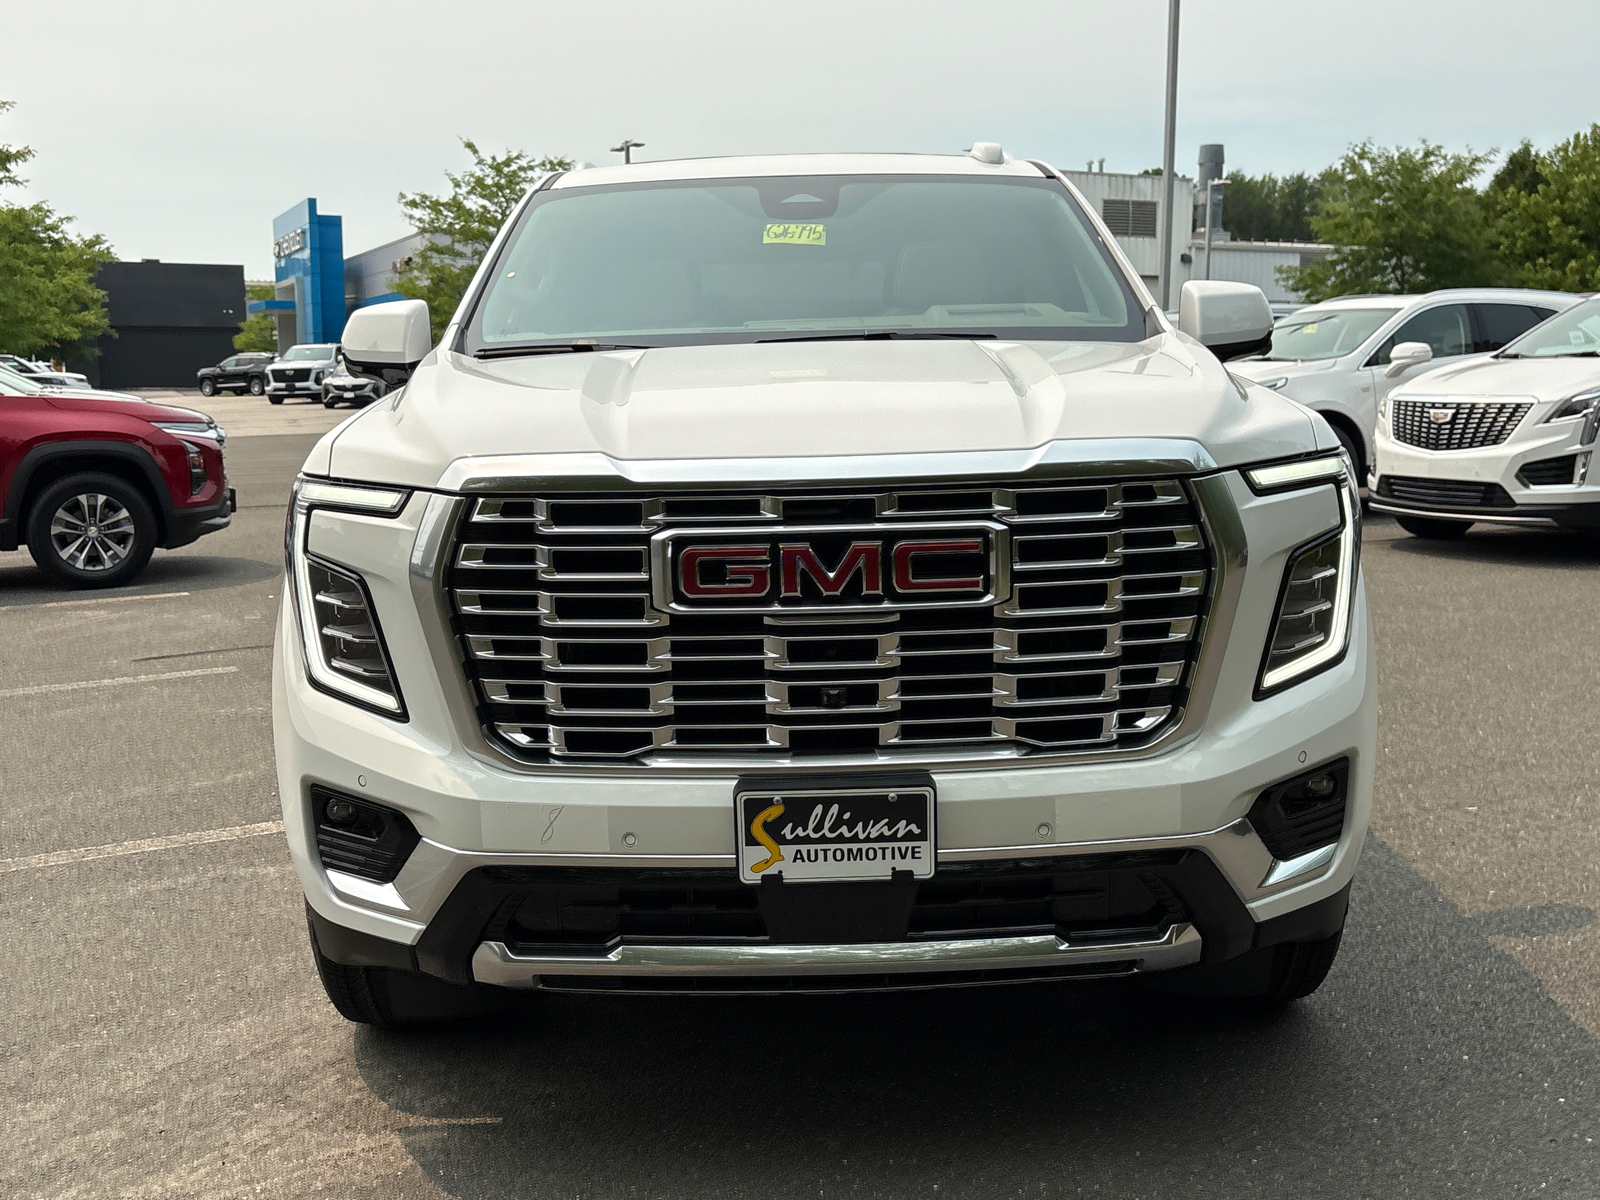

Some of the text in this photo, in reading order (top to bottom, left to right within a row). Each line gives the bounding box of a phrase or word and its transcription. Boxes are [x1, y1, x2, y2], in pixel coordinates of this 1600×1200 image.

[679, 539, 984, 598] GMC
[750, 803, 921, 873] Sullivan
[792, 846, 922, 863] AUTOMOTIVE
